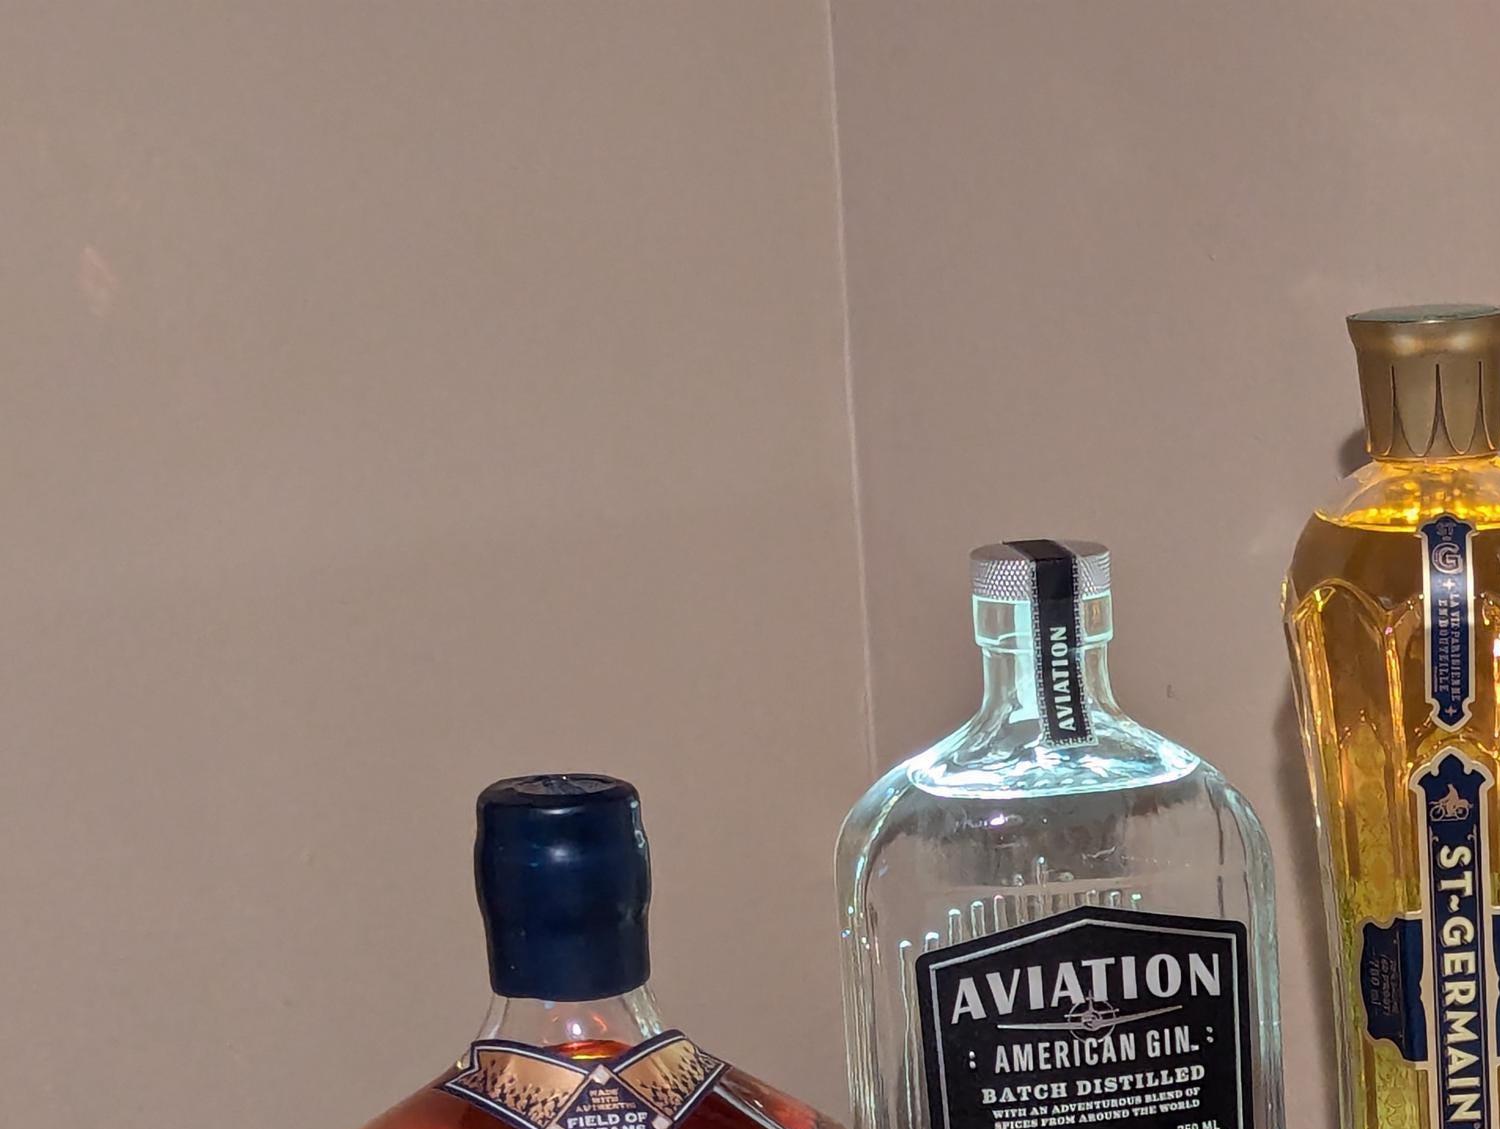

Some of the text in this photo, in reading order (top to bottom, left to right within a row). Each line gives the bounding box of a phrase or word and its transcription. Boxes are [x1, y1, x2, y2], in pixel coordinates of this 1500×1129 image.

[1050, 627, 1077, 731] AVIATION
[951, 953, 1221, 1024] AVIATION
[995, 1032, 1136, 1074] AMERICAN
[982, 1065, 1205, 1105] BATCH DISTILLED
[992, 1087, 1201, 1120] WITH AN ADVENTUROUS BLEND OF
[567, 1112, 648, 1129] FIELD OF
[1041, 1115, 1076, 1127] FROM
[1078, 1109, 1130, 1124] AROUND
[1132, 1105, 1157, 1117] THE
[1159, 1099, 1200, 1113] WORLD
